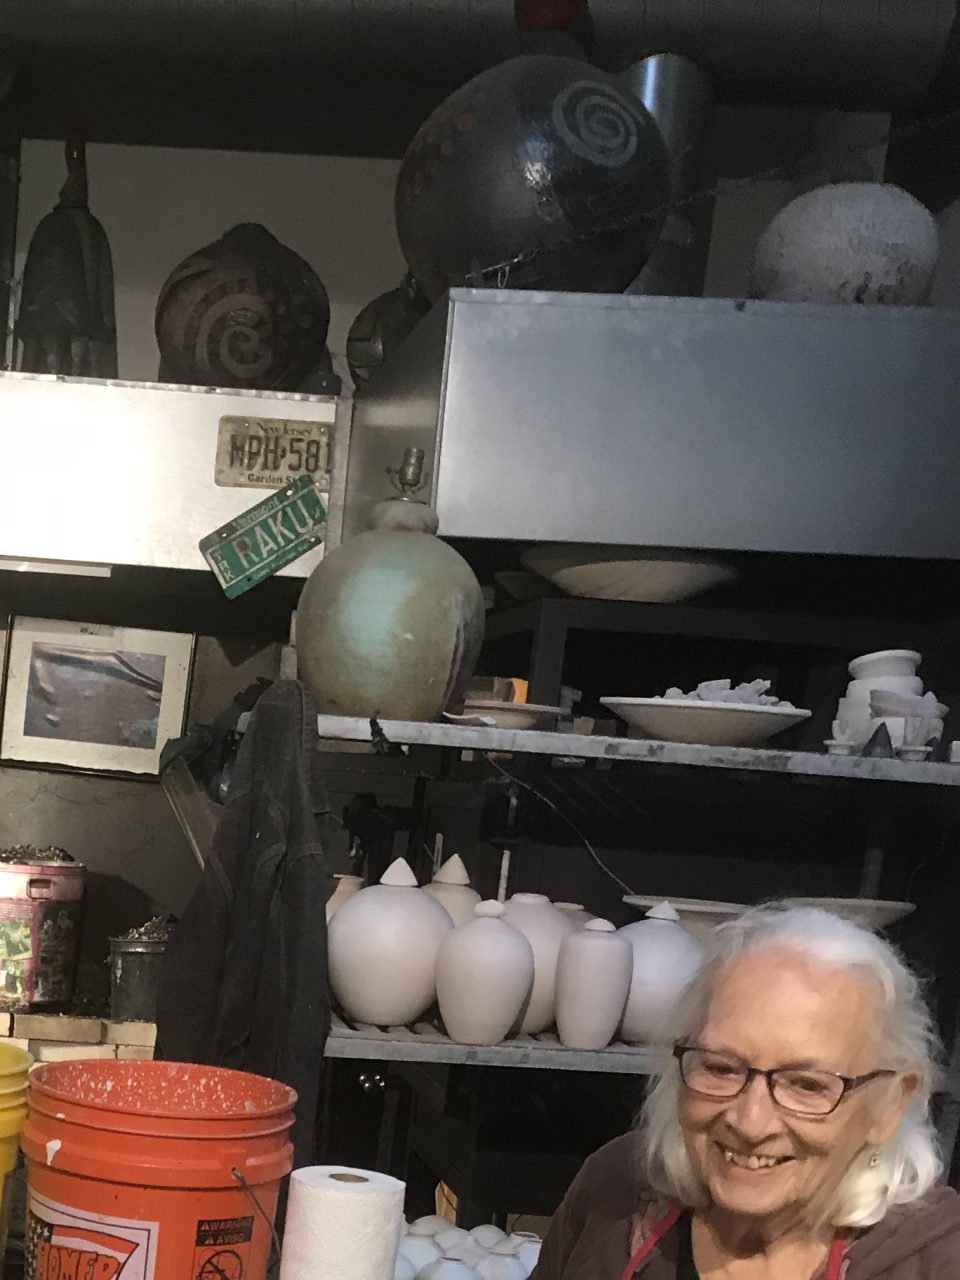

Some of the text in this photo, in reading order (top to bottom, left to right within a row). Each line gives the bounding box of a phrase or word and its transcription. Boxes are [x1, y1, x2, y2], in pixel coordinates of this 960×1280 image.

[282, 424, 312, 436] Jersey
[248, 473, 282, 484] Garden
[233, 496, 280, 530] Vermont
[231, 499, 315, 570] RAKU
